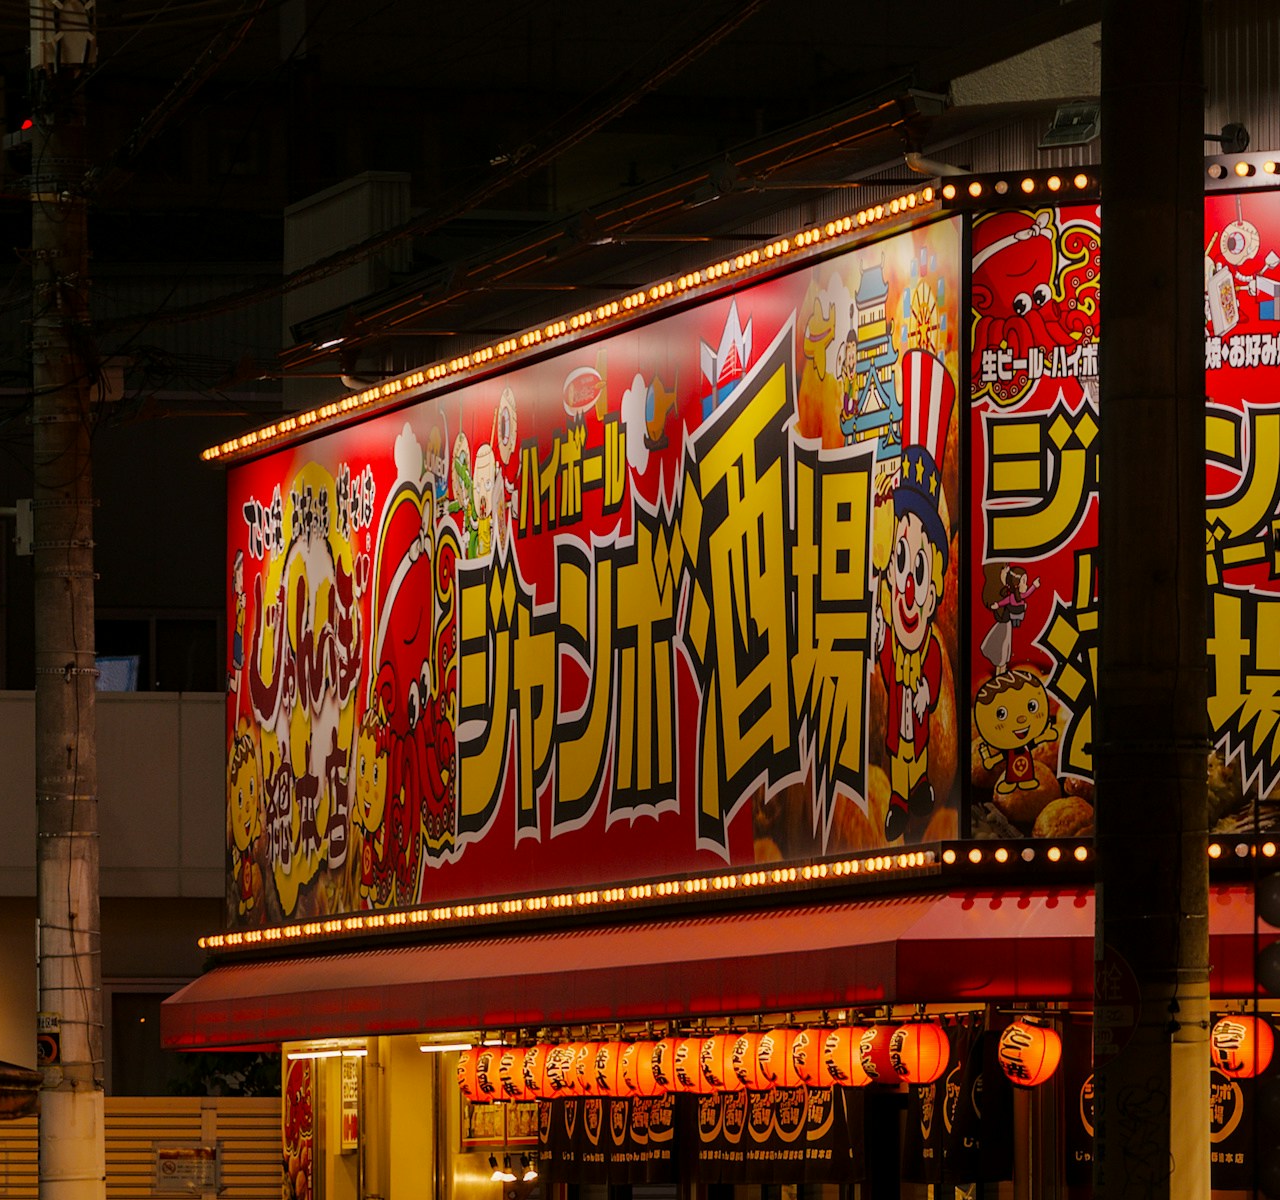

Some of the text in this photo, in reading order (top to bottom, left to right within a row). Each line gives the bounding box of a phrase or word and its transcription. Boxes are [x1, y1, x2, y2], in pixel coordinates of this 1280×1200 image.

[982, 347, 1044, 382] 生ビール
[518, 410, 628, 539] ハイボール
